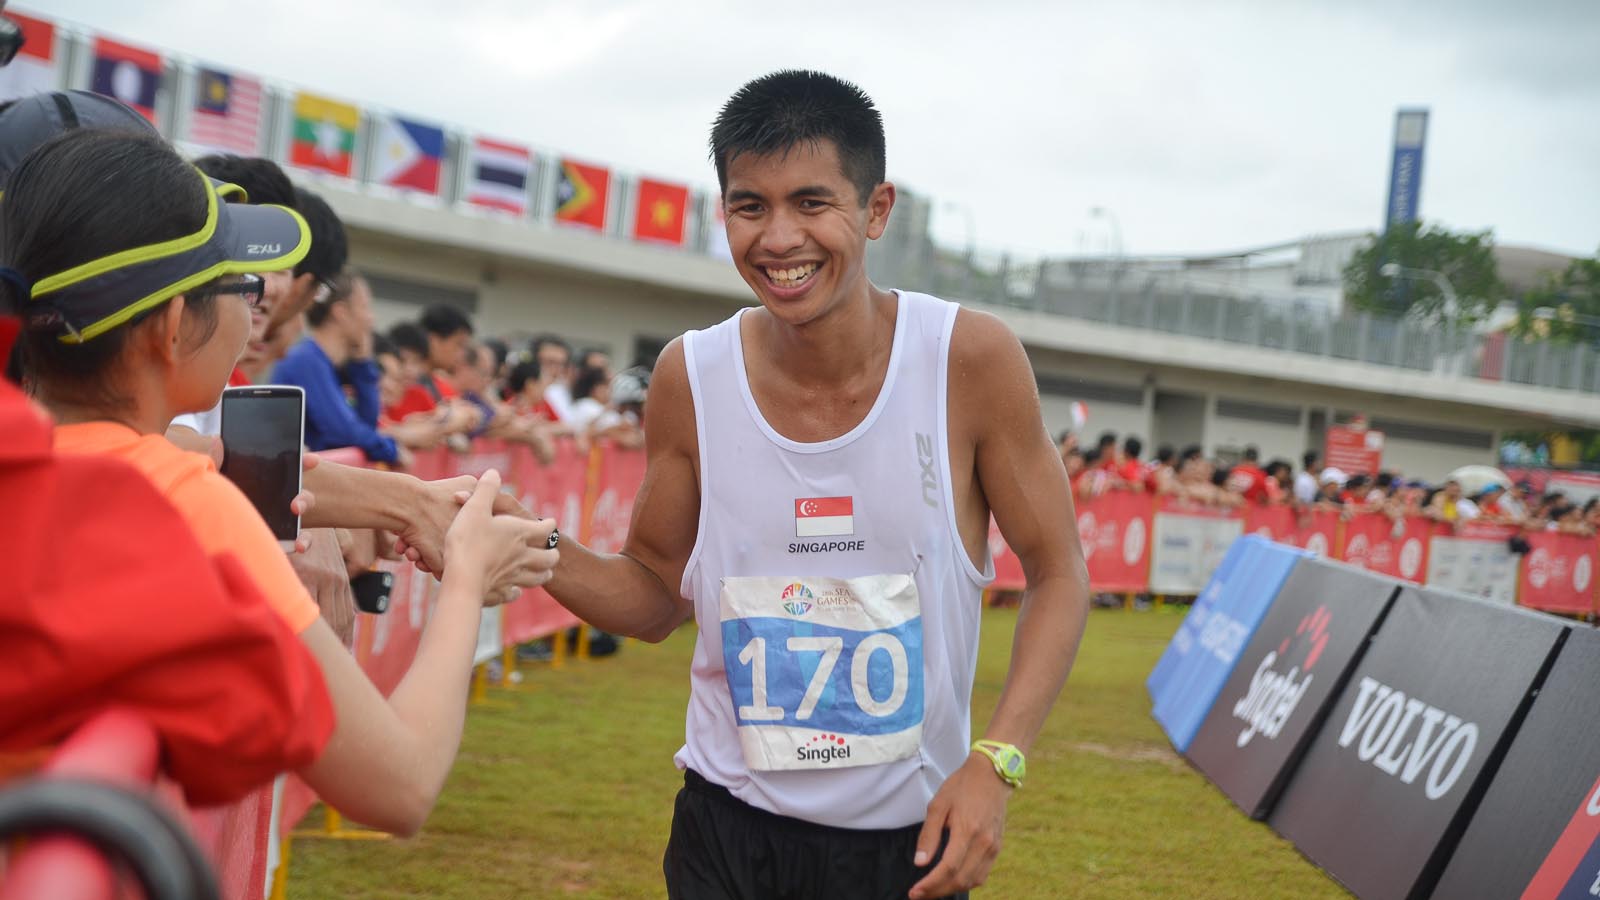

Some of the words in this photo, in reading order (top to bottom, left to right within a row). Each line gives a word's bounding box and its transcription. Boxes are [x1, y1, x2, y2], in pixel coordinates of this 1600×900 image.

[247, 243, 281, 254] 2XU
[915, 431, 939, 508] 2XU
[788, 540, 865, 553] SINGAPORE
[816, 597, 849, 606] GAMES
[738, 632, 909, 722] 170
[1232, 650, 1314, 748] Singtel
[797, 745, 851, 763] Singtel
[1338, 676, 1480, 800] VOLVO
